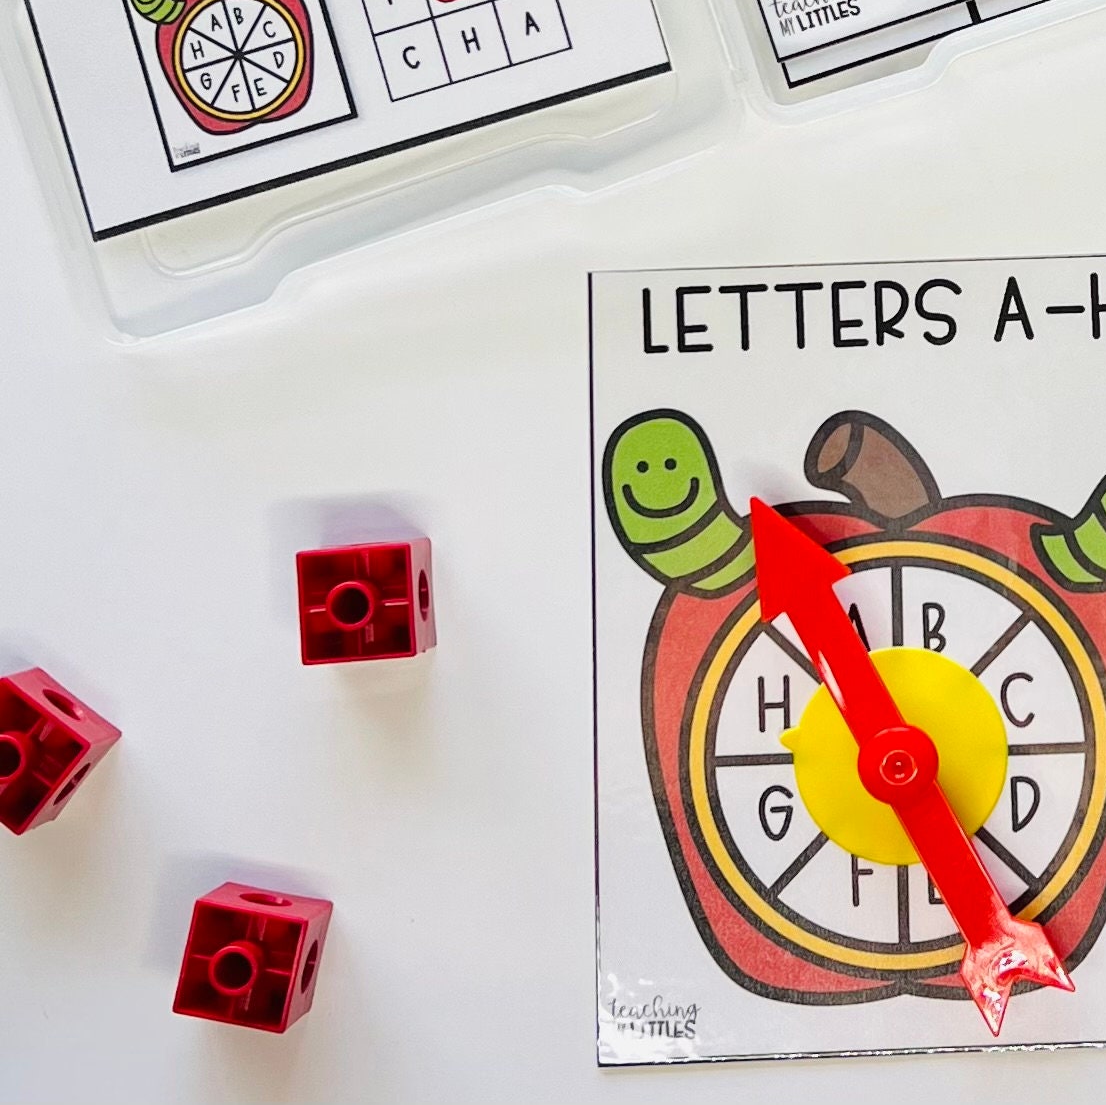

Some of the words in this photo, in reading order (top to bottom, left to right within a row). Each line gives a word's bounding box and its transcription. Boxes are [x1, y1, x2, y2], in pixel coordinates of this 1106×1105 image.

[211, 13, 223, 32] A
[233, 7, 244, 25] B
[525, 11, 540, 36] A
[780, 17, 795, 36] MY
[263, 20, 277, 38] C
[461, 27, 481, 54] H
[190, 39, 205, 60] H
[273, 51, 285, 69] D
[403, 45, 421, 70] C
[200, 72, 212, 91] G
[231, 83, 241, 103] F
[253, 77, 267, 97] E
[642, 278, 963, 355] LETTERS
[922, 602, 947, 653] B
[757, 674, 791, 733] H
[1000, 672, 1035, 728] C
[757, 784, 794, 842] G
[1010, 775, 1041, 833] D
[607, 995, 702, 1025] teaching
